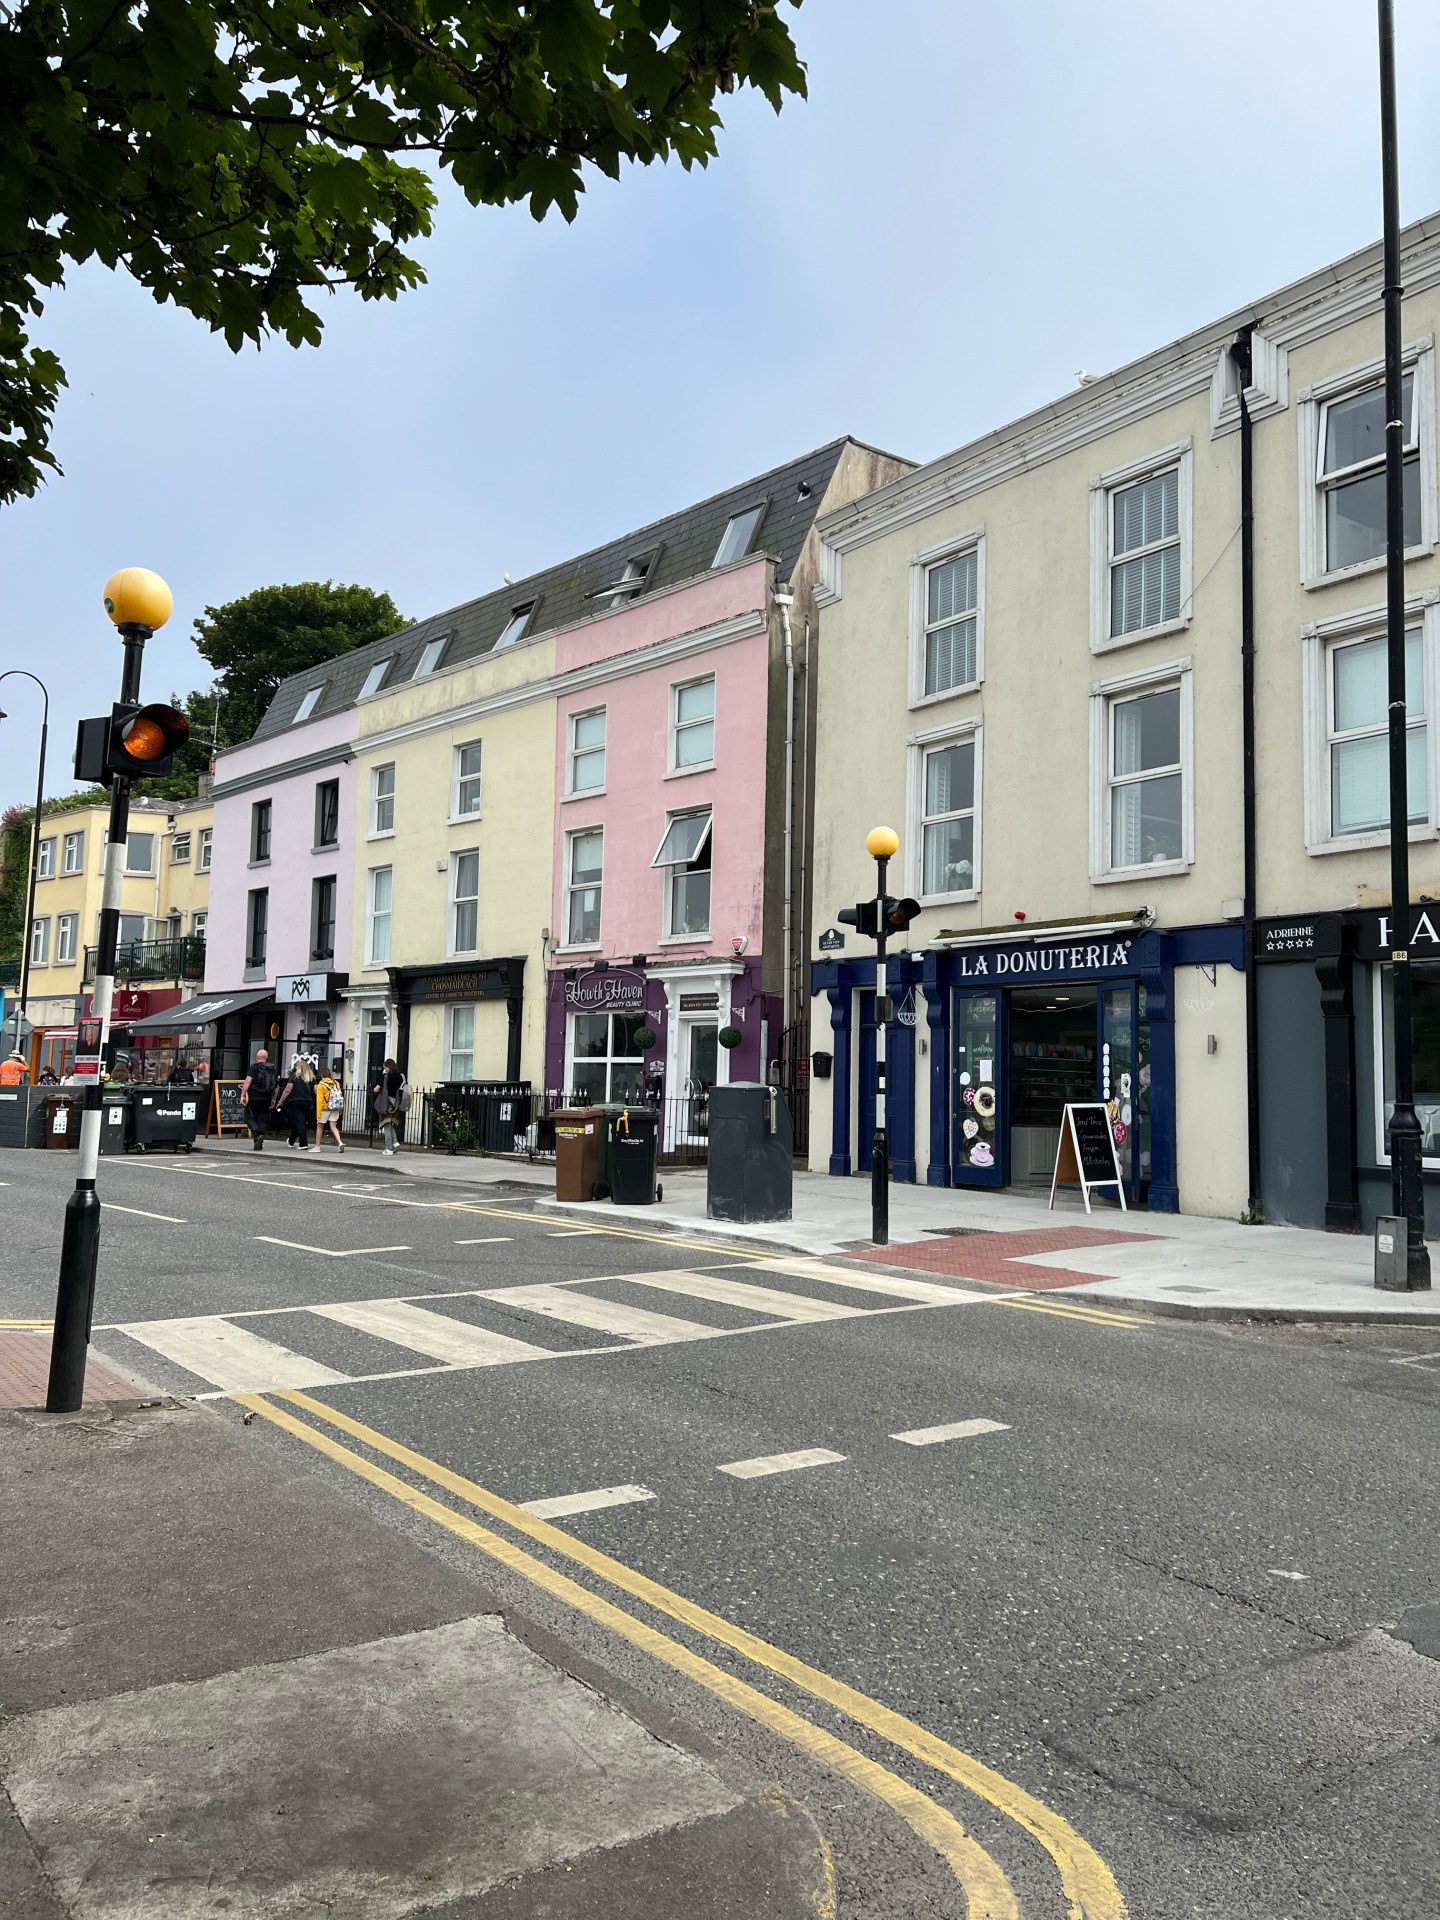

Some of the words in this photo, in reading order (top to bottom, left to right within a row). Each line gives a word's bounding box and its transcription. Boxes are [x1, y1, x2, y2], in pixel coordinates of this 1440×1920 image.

[1266, 926, 1314, 939] ADRIENNE
[961, 955, 989, 976] LA
[565, 980, 603, 1003] Howth
[604, 979, 643, 1001] Haven
